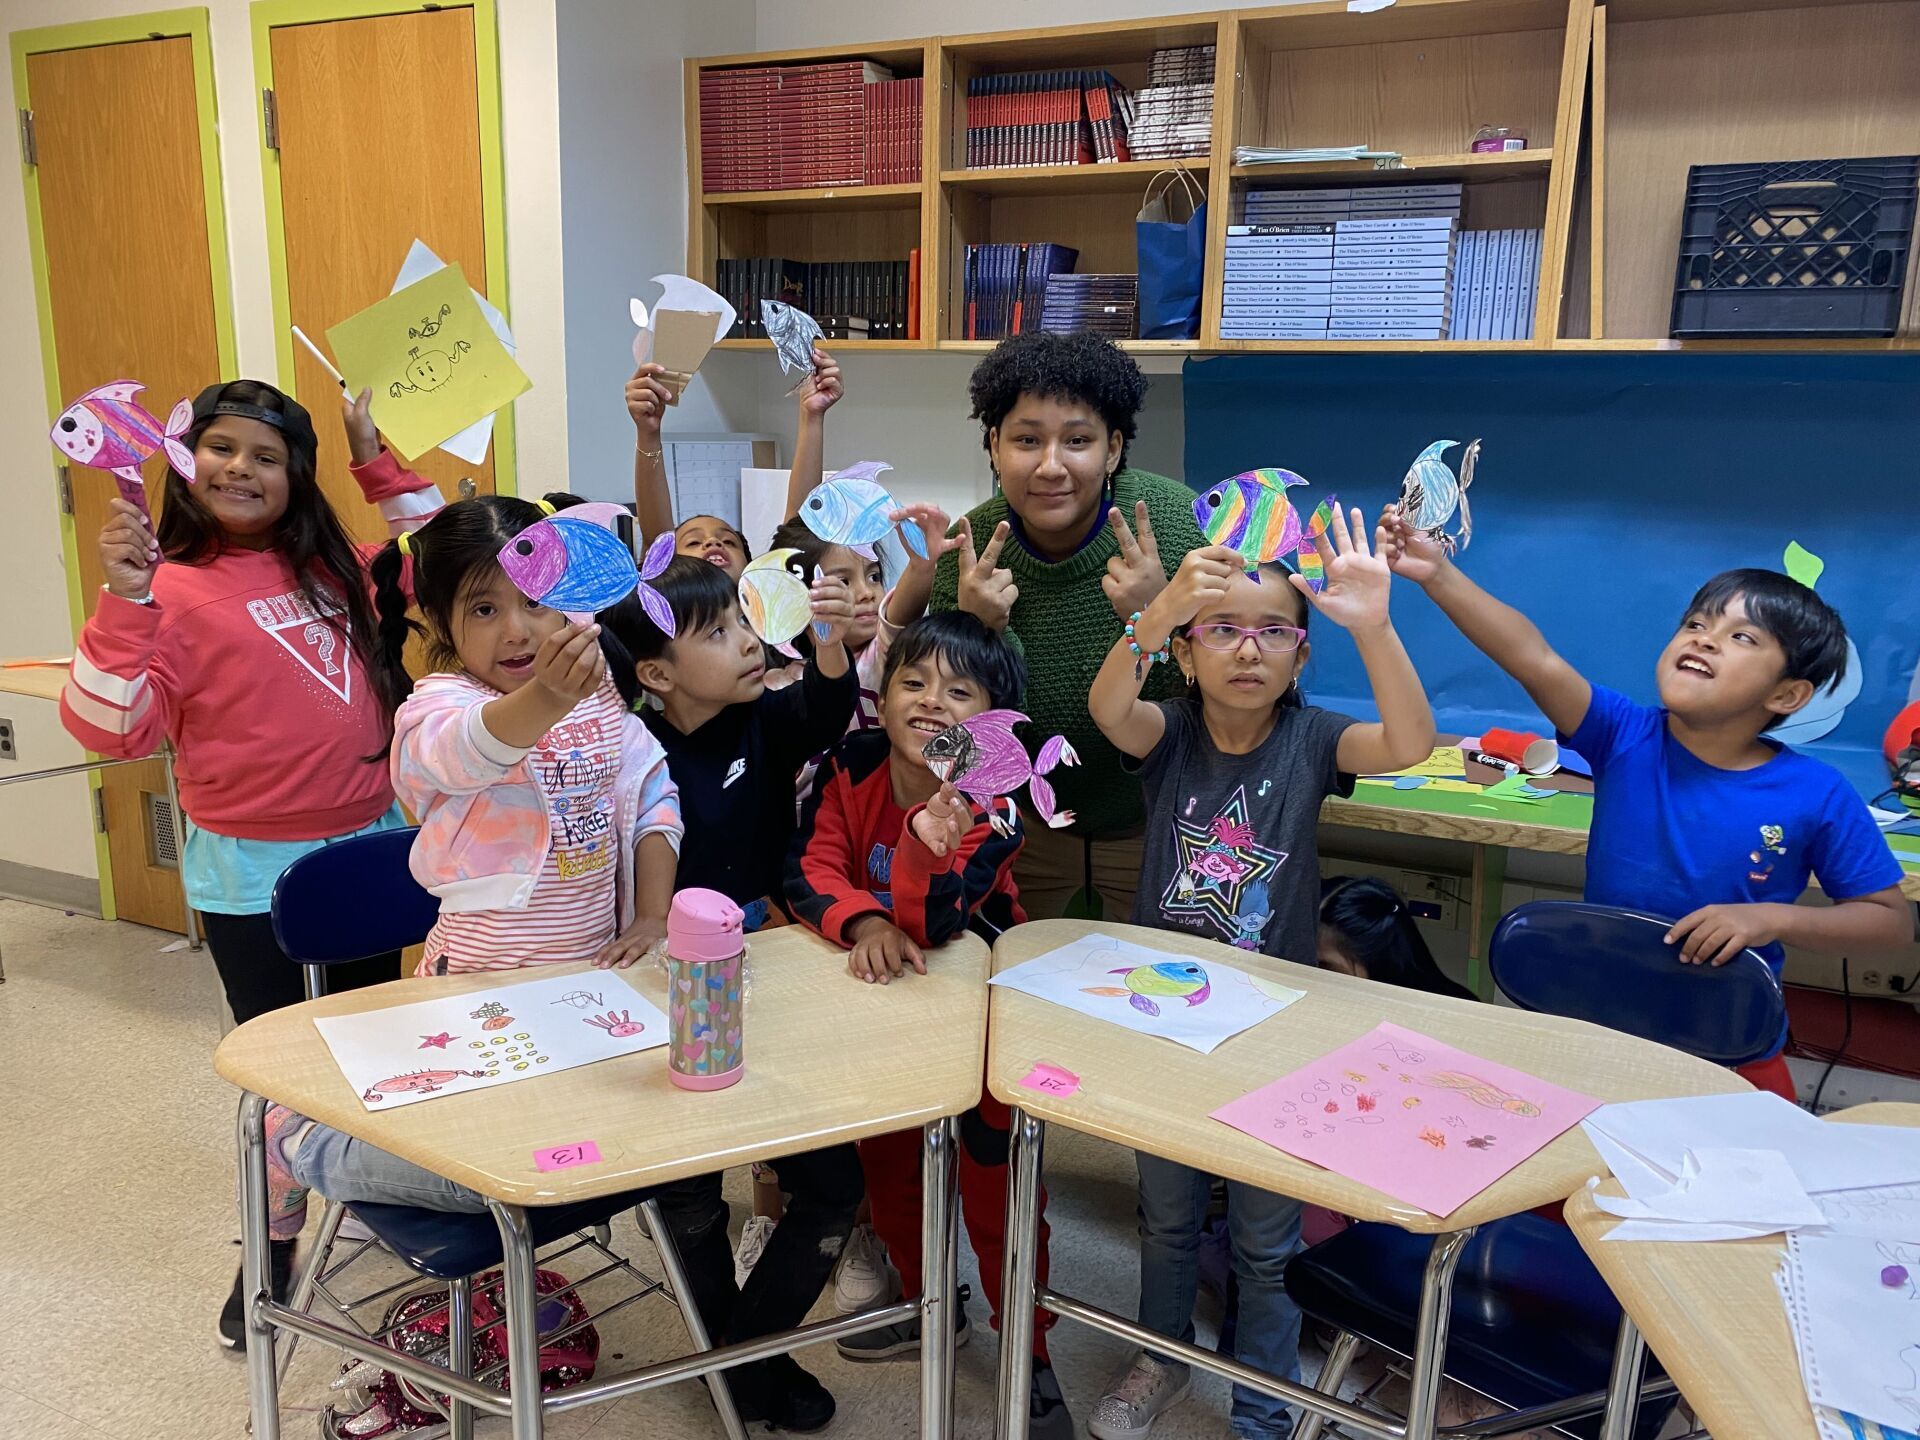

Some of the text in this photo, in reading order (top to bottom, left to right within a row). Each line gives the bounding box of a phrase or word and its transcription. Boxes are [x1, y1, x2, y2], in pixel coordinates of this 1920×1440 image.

[1269, 225, 1290, 233] O'Brien
[247, 584, 345, 628] GUE
[725, 758, 746, 779] NIKE
[561, 811, 609, 847] FORGET
[556, 836, 609, 882] kind
[1039, 1077, 1066, 1091] 29
[551, 1146, 584, 1166] 13
